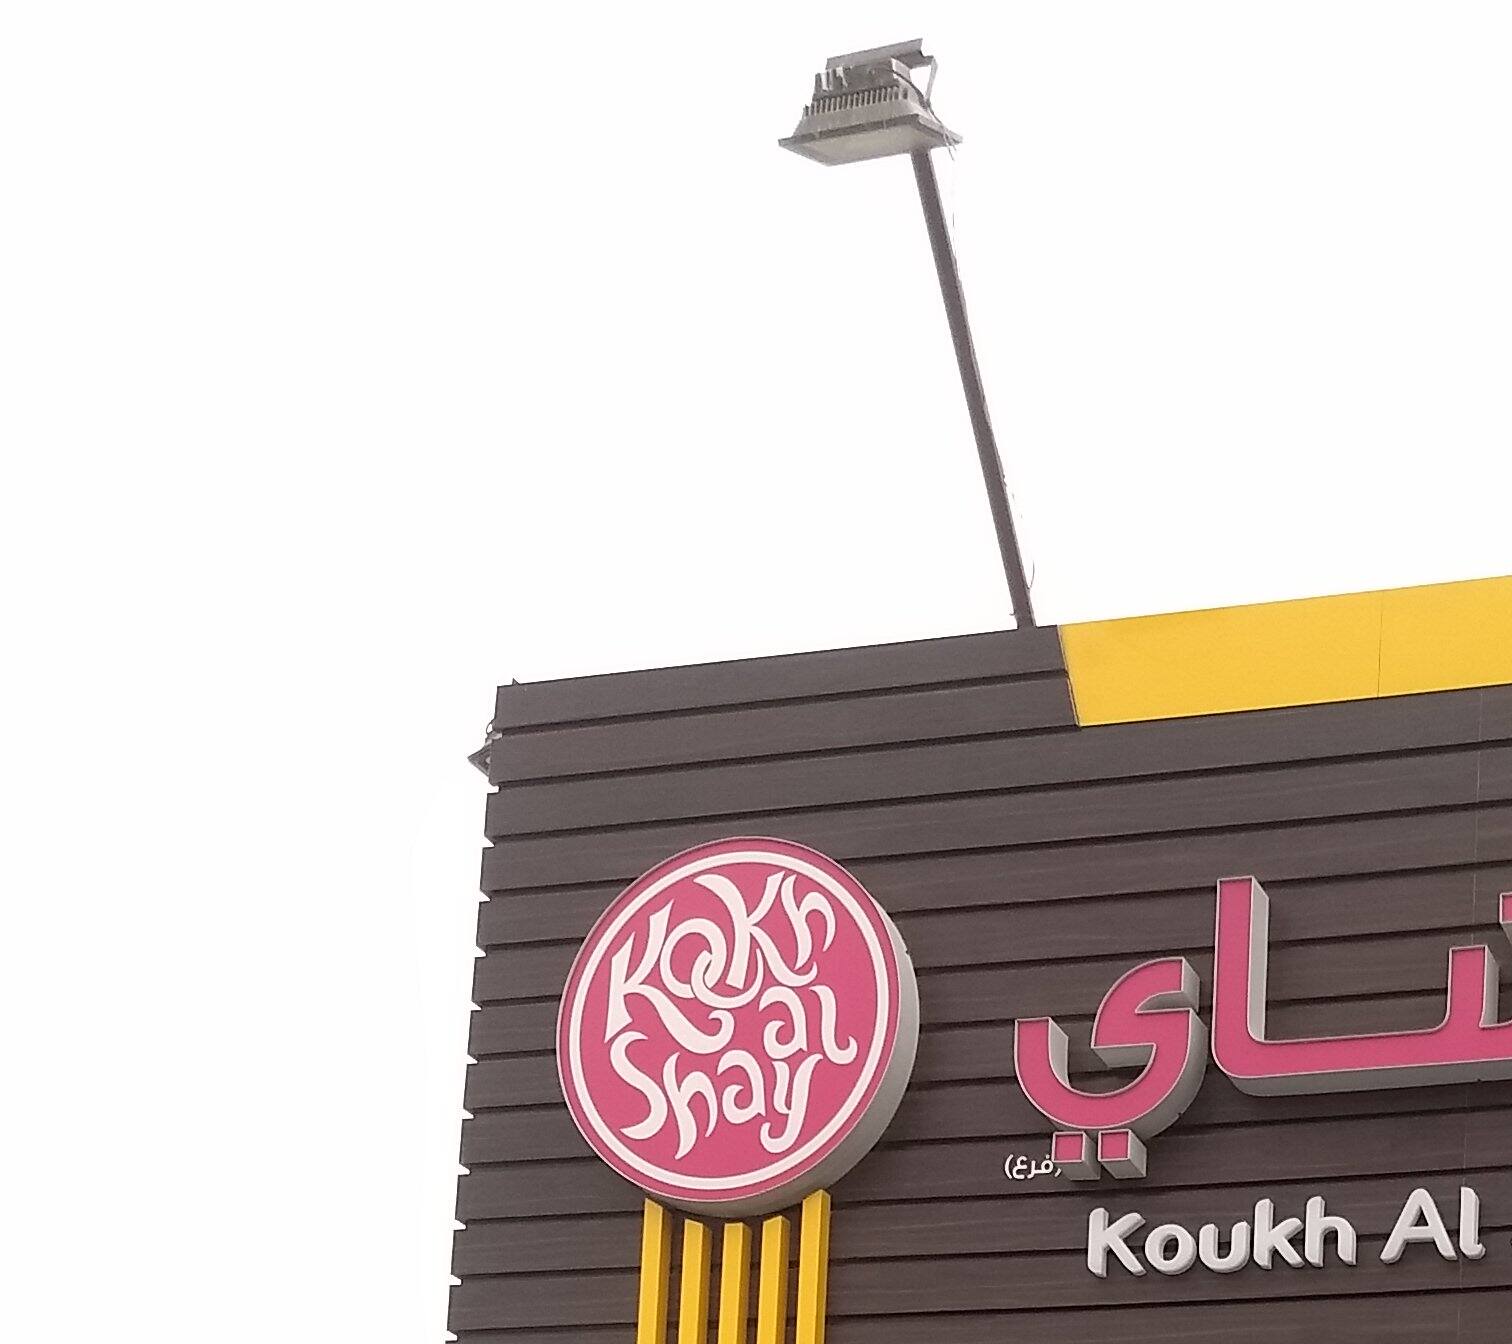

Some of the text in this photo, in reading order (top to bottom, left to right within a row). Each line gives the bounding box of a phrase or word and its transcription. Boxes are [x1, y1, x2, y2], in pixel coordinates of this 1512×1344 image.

[609, 1030, 824, 1160] Shay
[1087, 1197, 1359, 1279] Koukh
[1380, 1186, 1486, 1265] Al
